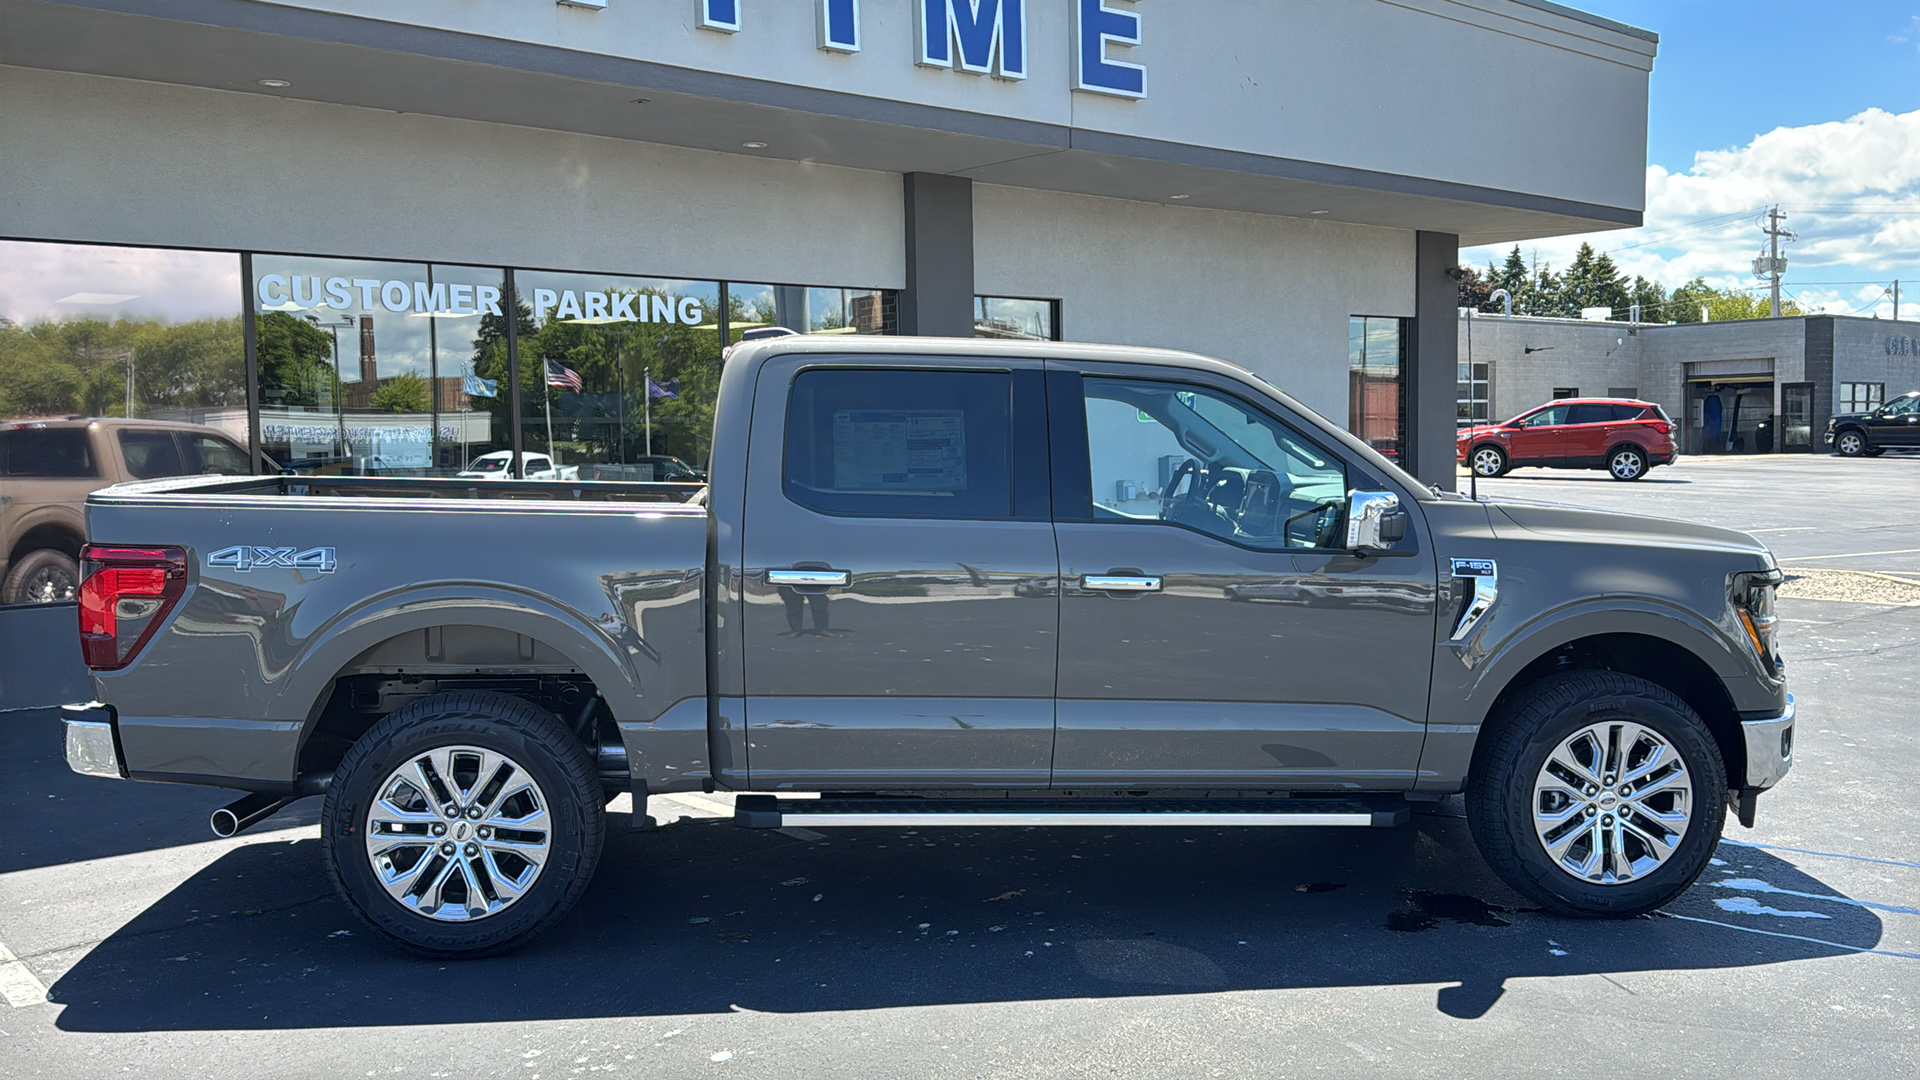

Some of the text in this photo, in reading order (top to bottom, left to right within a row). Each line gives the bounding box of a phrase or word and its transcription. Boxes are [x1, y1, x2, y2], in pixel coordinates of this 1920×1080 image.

[258, 273, 703, 326] CUSTOMER PARKING
[1455, 561, 1492, 569] F-150
